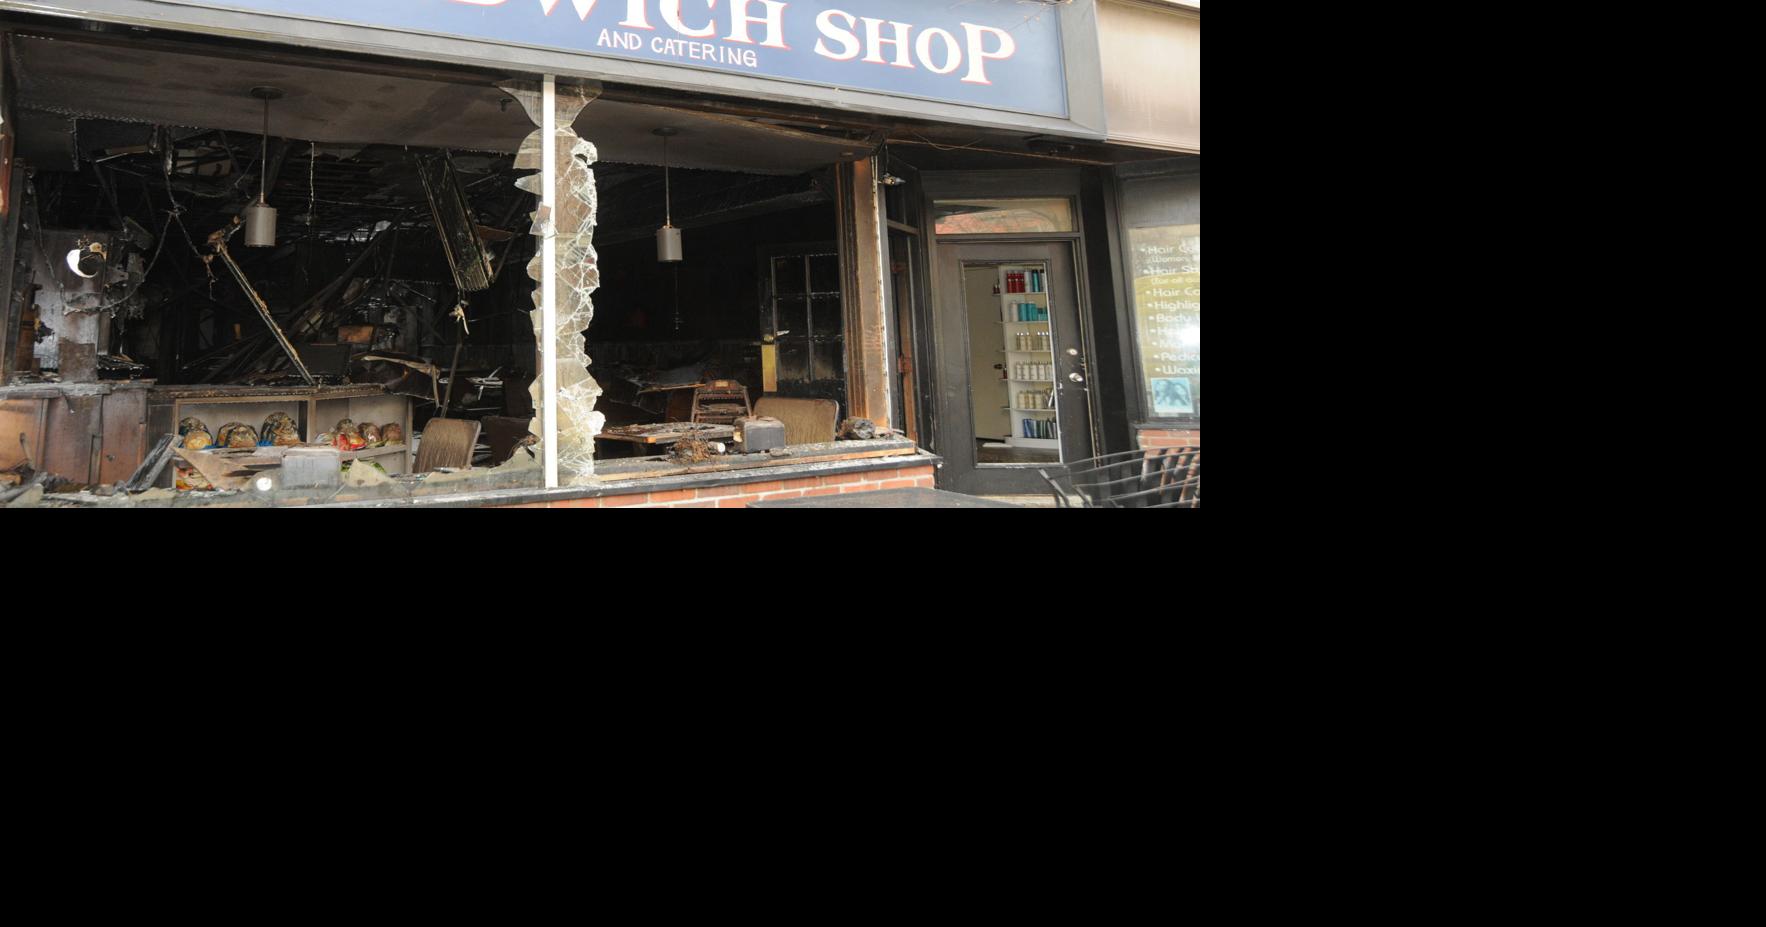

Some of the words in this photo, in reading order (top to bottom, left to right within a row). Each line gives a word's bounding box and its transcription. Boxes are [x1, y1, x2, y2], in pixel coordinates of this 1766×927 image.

[597, 28, 642, 51] AND
[650, 37, 758, 68] CATERING
[813, 8, 1015, 85] SHOP
[1153, 287, 1180, 297] Hair
[1156, 313, 1192, 324] Body
